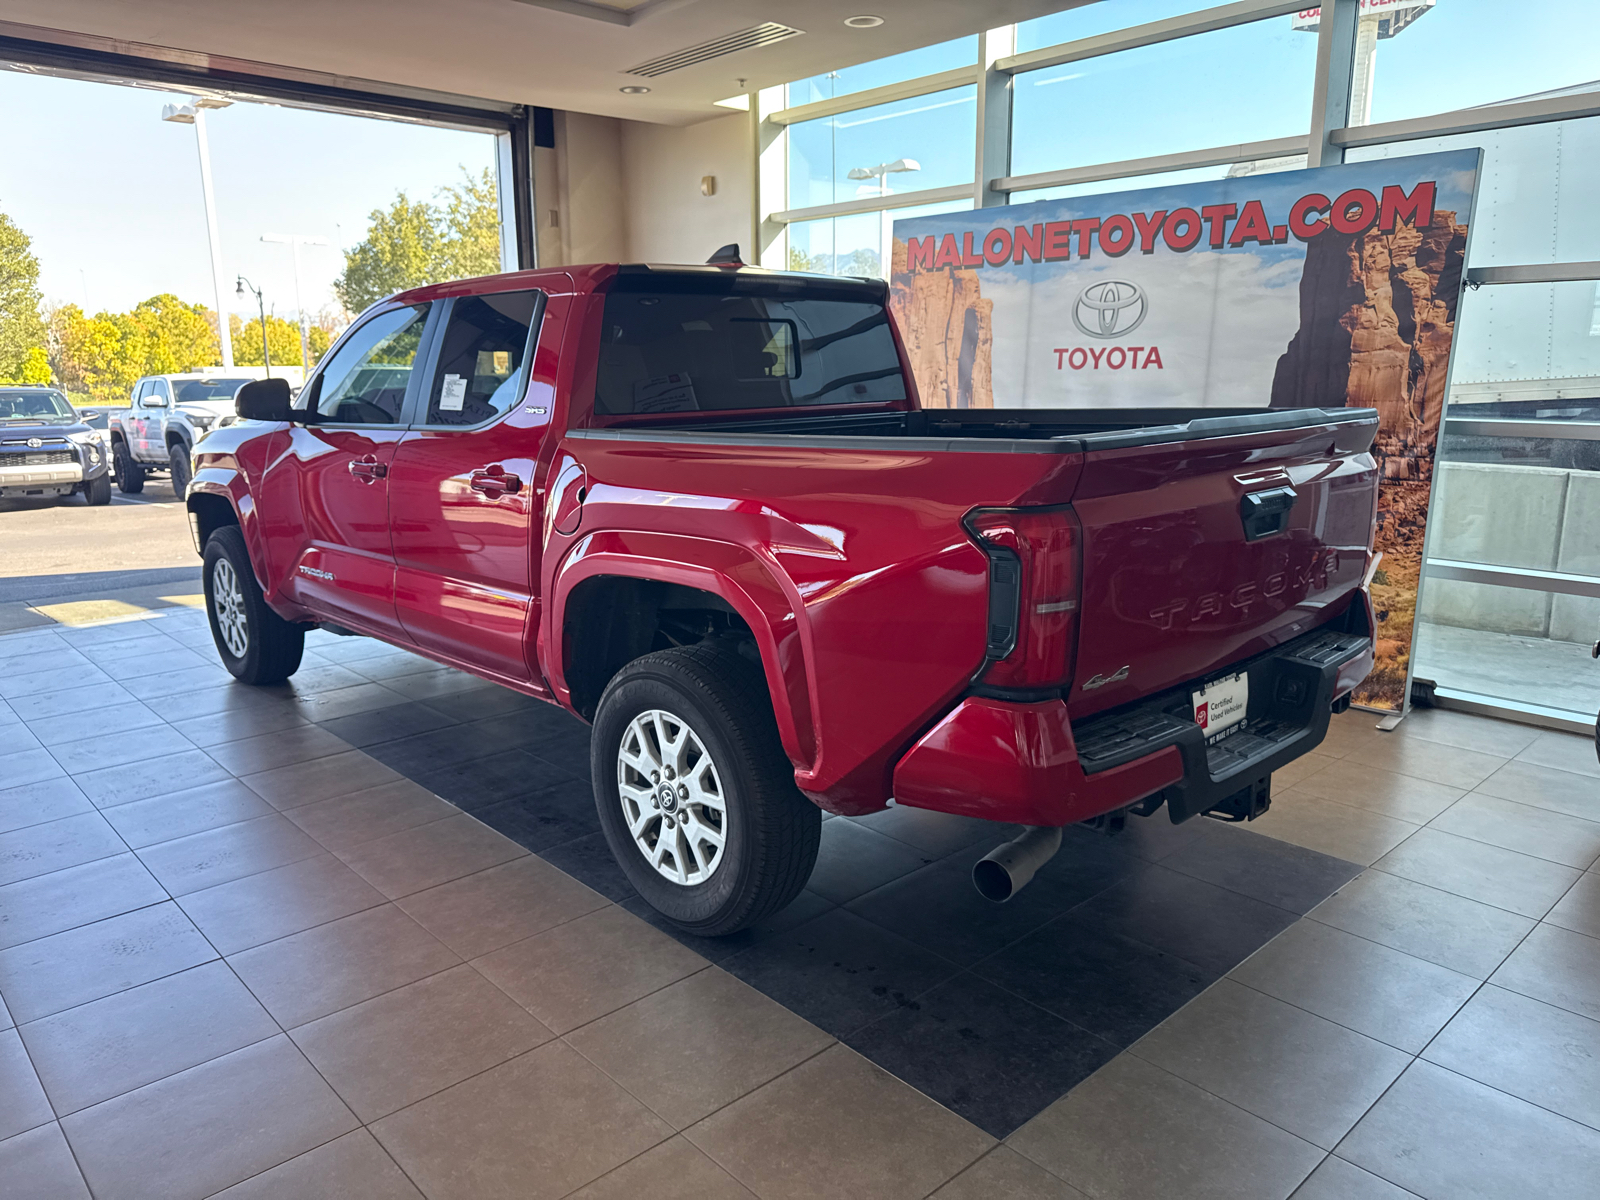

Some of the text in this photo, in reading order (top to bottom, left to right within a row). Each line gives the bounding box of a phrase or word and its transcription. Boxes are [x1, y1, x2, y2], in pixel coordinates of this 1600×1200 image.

[907, 181, 1437, 273] MALONETOYOTA.COM
[1053, 346, 1164, 371] TOYOTA
[1150, 548, 1340, 630] TACOMA
[1210, 696, 1233, 711] Certified
[1210, 703, 1243, 722] Used Vehicles
